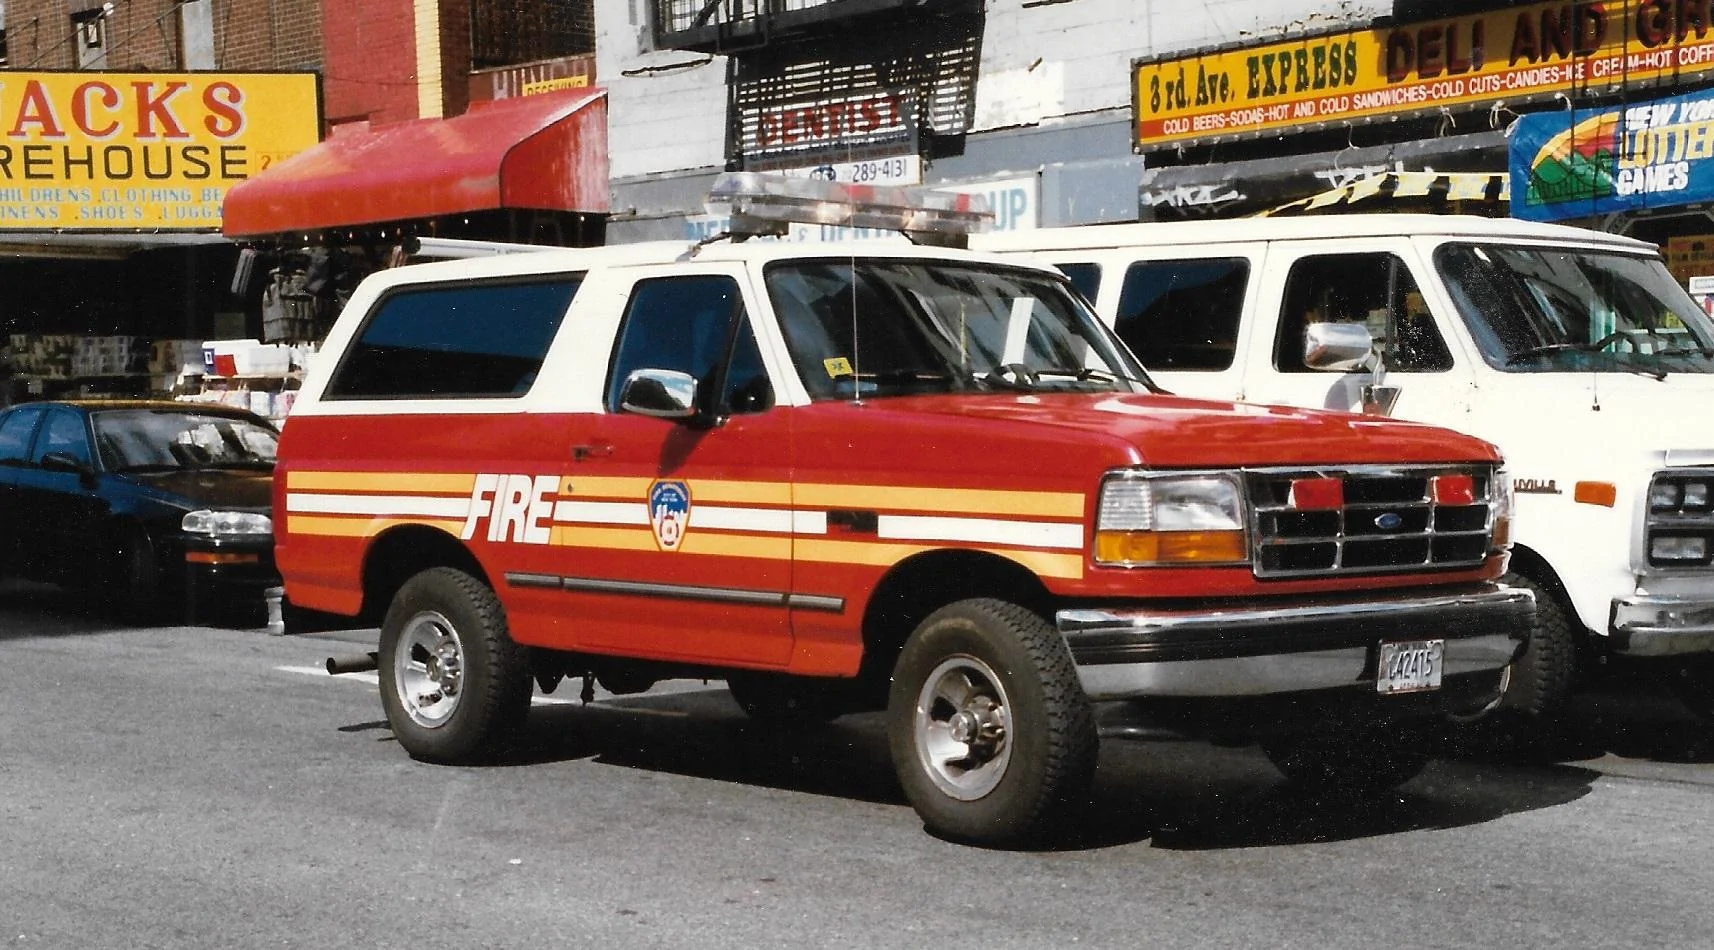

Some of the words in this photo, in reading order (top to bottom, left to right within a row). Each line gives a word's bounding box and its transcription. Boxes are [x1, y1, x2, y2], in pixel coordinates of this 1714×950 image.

[1386, 19, 1485, 83] DELI
[1509, 2, 1608, 67] AND
[1637, 0, 1714, 49] GR
[1246, 40, 1358, 99] EXPRESS
[0, 80, 247, 141] ACKS
[756, 94, 907, 147] DENTIST
[1163, 117, 1190, 135] COLD
[1294, 100, 1316, 118] AND
[1319, 96, 1350, 115] COLD
[1353, 79, 1464, 110] SANDWICHES-COLD
[1625, 103, 1677, 130] NEW
[0, 144, 248, 180] REHOUSE
[852, 159, 907, 183] 289-4131
[1616, 160, 1689, 197] GAMES
[460, 473, 561, 545] FIRE
